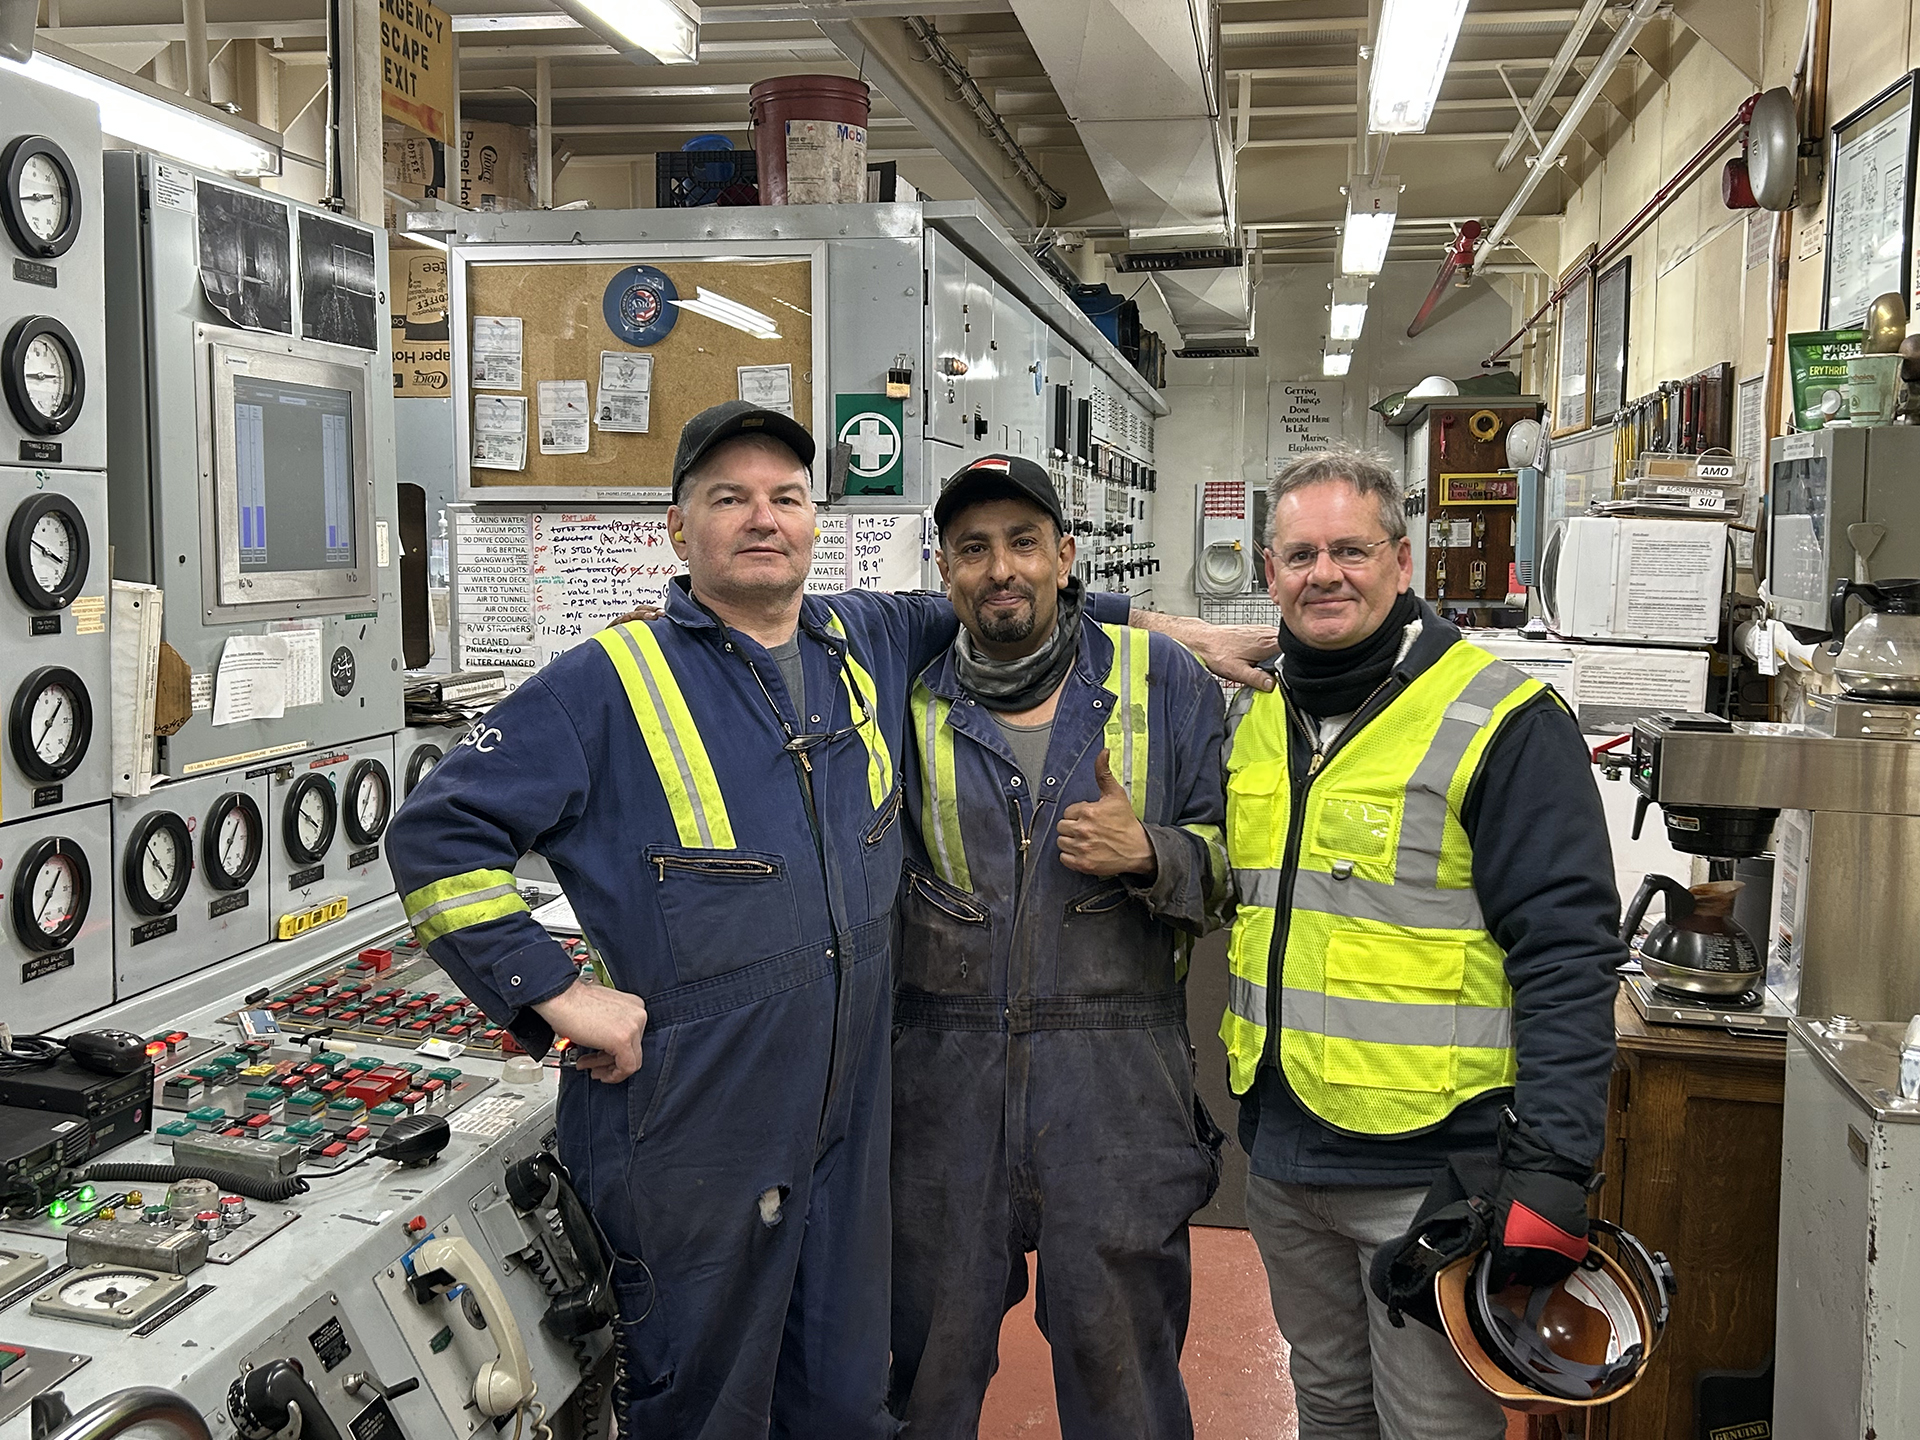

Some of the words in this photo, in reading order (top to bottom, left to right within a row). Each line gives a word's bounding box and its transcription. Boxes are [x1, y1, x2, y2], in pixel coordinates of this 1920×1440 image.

[380, 0, 443, 44] RGENCY
[384, 56, 417, 98] EXIT
[1374, 199, 1380, 209] E
[632, 298, 651, 308] AMO
[1822, 343, 1862, 352] WHOLE
[1810, 365, 1848, 376] ERYTHRIT
[1701, 468, 1729, 476] AMO
[1451, 481, 1478, 490] Group
[1666, 486, 1714, 496] AGREEMENTS
[1698, 498, 1717, 506] SIU
[822, 520, 847, 528] DATE:
[808, 582, 847, 590] SEWAGE:
[467, 624, 484, 632] R/W
[542, 624, 582, 636] 11-18-24
[472, 638, 509, 646] CLEANED
[457, 722, 502, 752] SC
